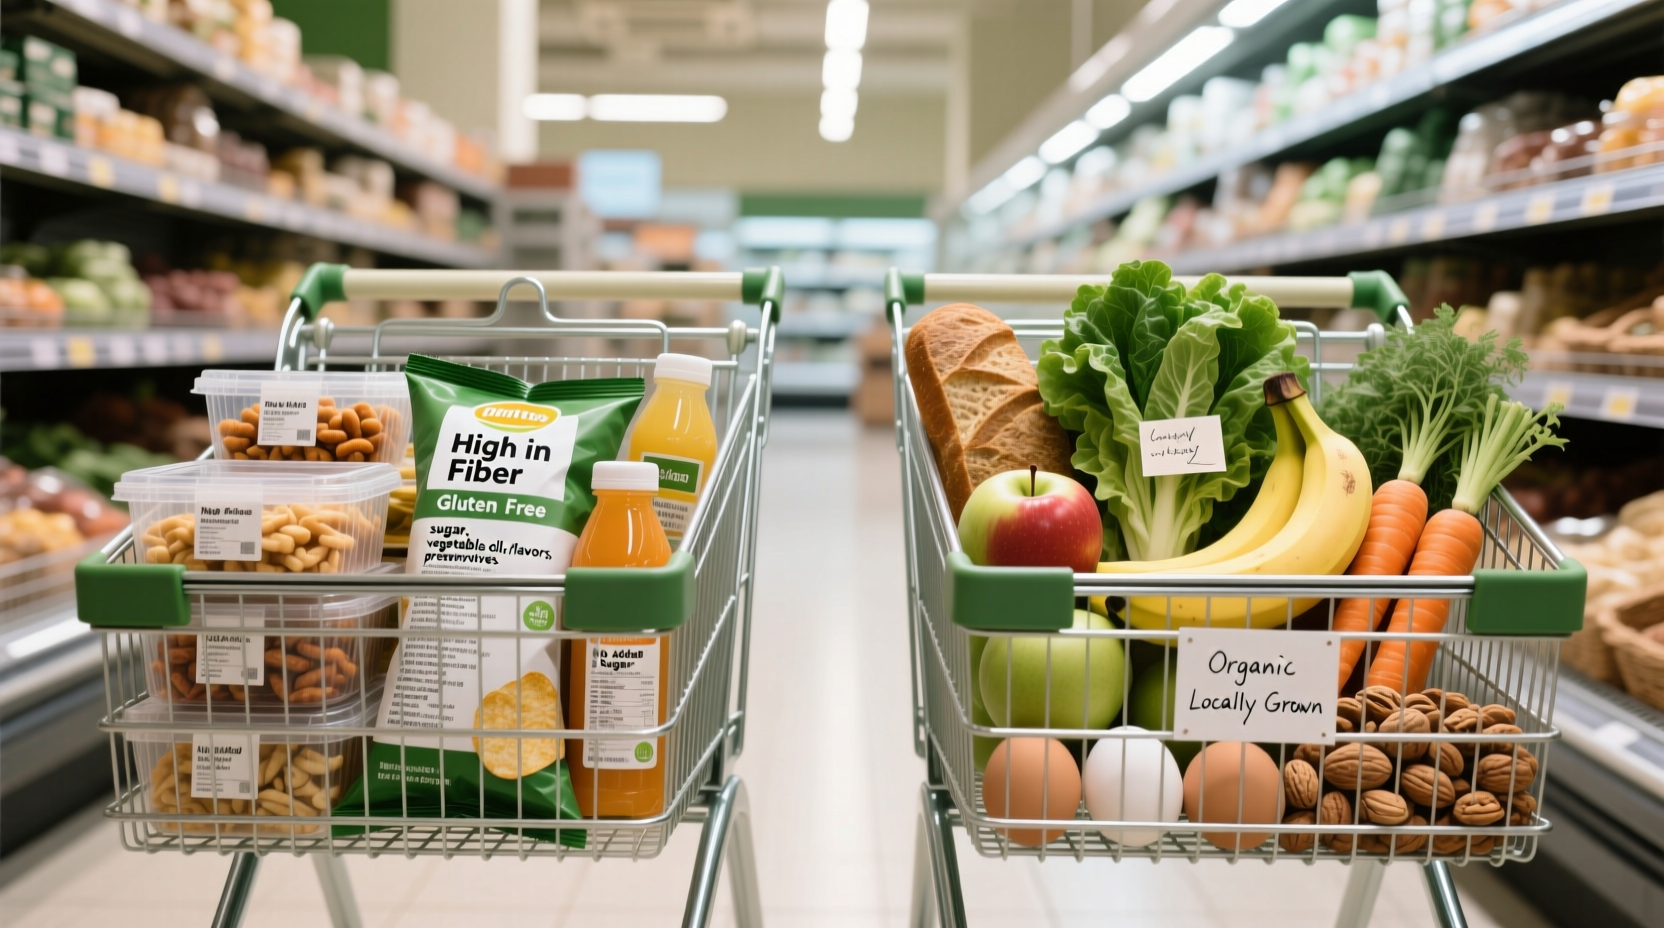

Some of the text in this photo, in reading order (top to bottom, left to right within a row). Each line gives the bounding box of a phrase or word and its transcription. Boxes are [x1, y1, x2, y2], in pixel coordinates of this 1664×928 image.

[451, 433, 551, 462] High in
[447, 459, 524, 485] Fiber
[437, 494, 547, 518] Gluten Free
[1208, 650, 1296, 687] Organic
[1189, 688, 1257, 726] Locally
